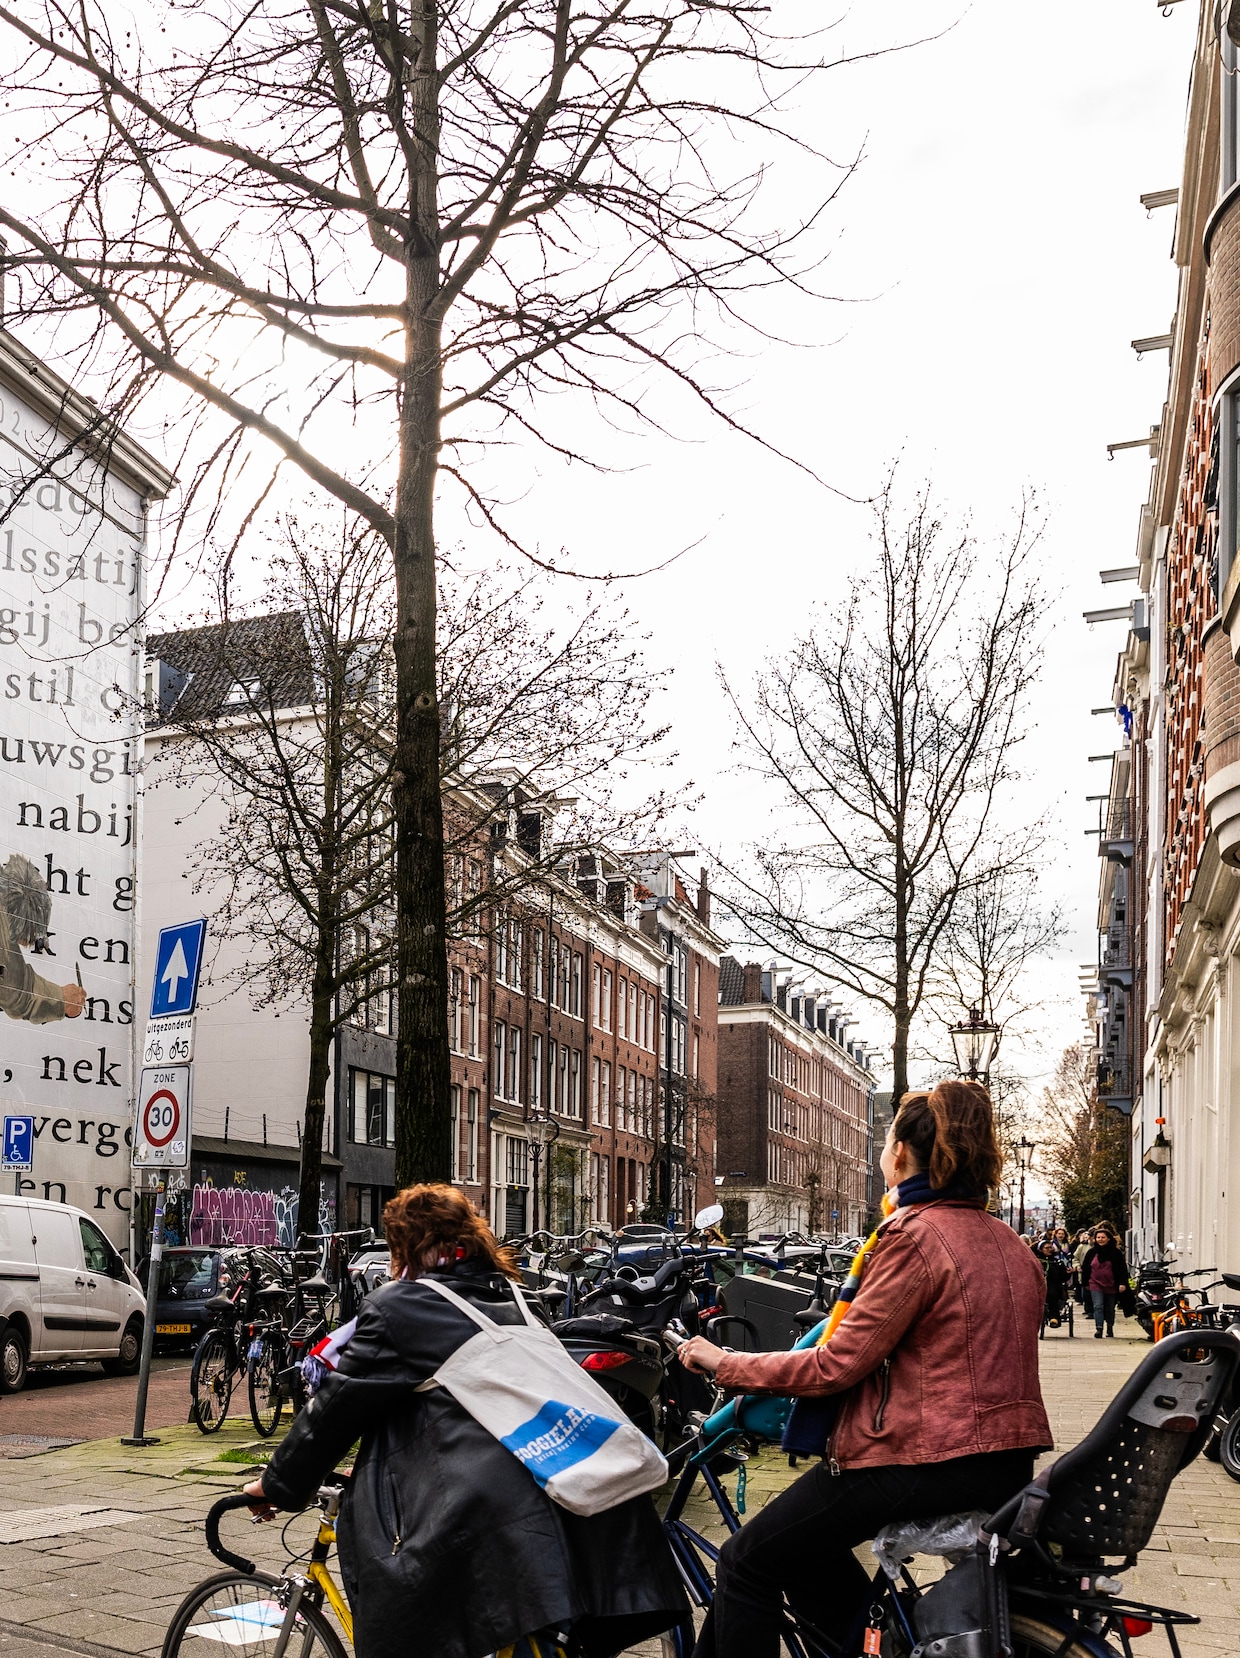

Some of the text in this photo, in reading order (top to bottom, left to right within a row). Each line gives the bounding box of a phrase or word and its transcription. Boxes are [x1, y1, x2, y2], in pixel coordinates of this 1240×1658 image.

[4, 665, 76, 708] stil
[16, 793, 133, 847] nabij
[79, 934, 130, 964] en
[146, 1019, 192, 1036] uitgezonderd
[40, 1047, 122, 1087] nek
[154, 1073, 176, 1084] ZONE
[150, 1106, 173, 1128] 30
[10, 1120, 27, 1144] P
